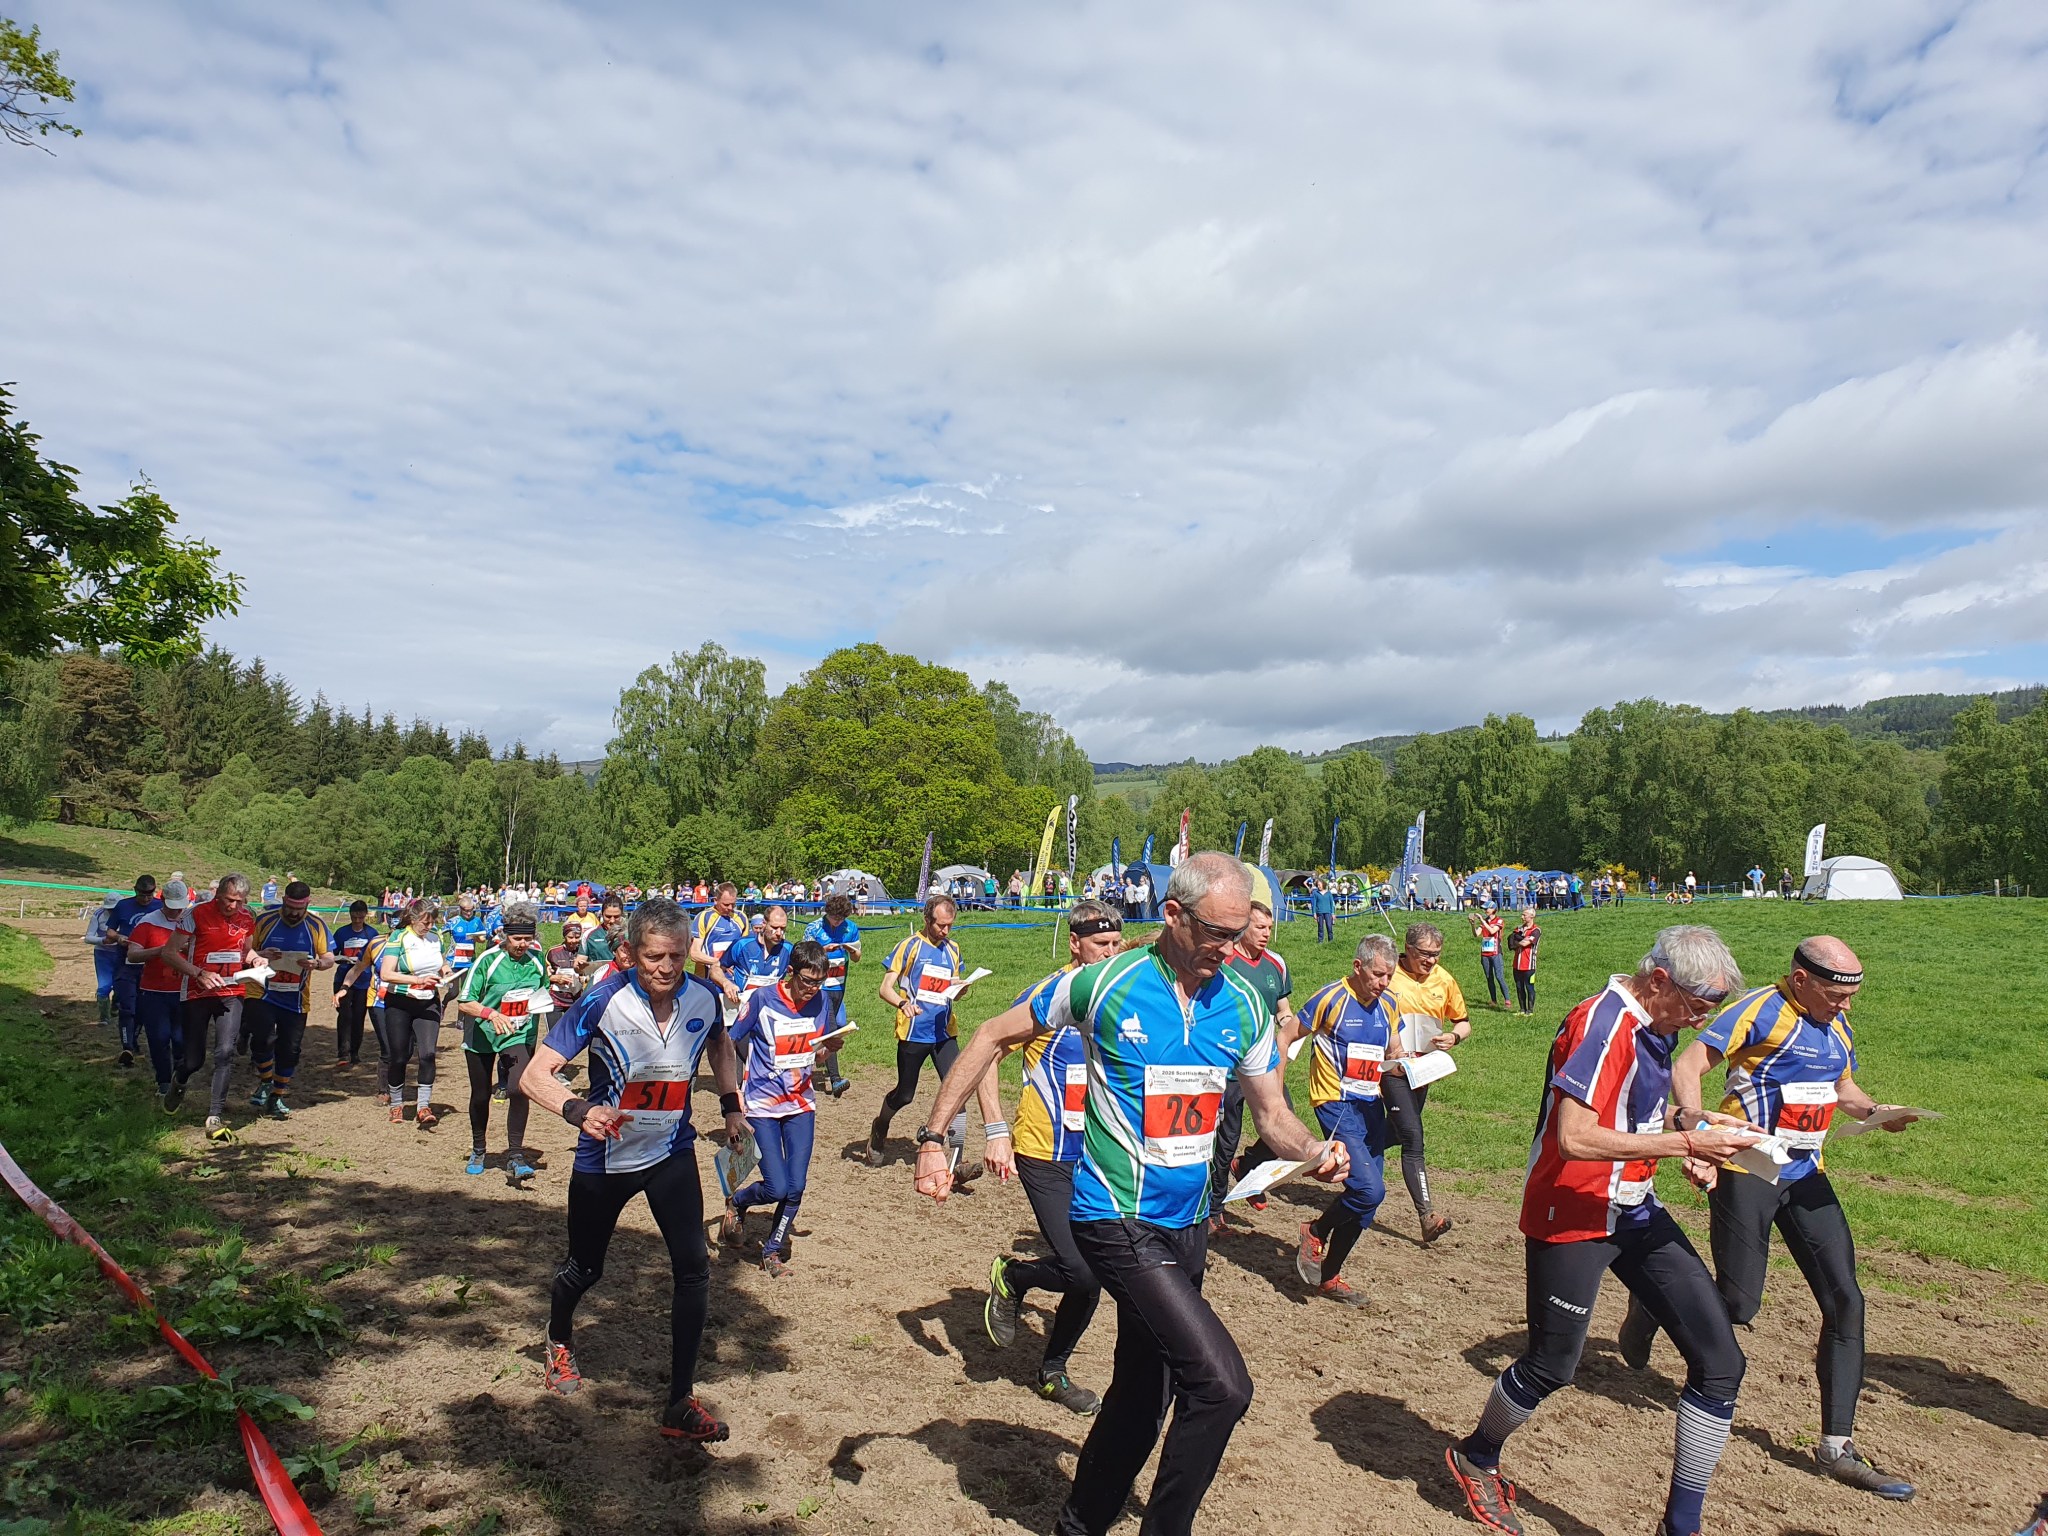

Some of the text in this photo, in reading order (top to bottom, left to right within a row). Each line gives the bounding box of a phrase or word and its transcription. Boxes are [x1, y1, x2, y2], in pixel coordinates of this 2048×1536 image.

[1068, 810, 1076, 863] INVOC
[928, 977, 943, 992] 32
[787, 1035, 807, 1054] 27
[1358, 1060, 1374, 1081] 46
[1565, 1074, 1588, 1091] TRIMTEX
[636, 1081, 670, 1110] 51
[1167, 1095, 1203, 1136] 26
[1798, 1105, 1825, 1131] 60
[1549, 1295, 1589, 1315] TRIMTEX
